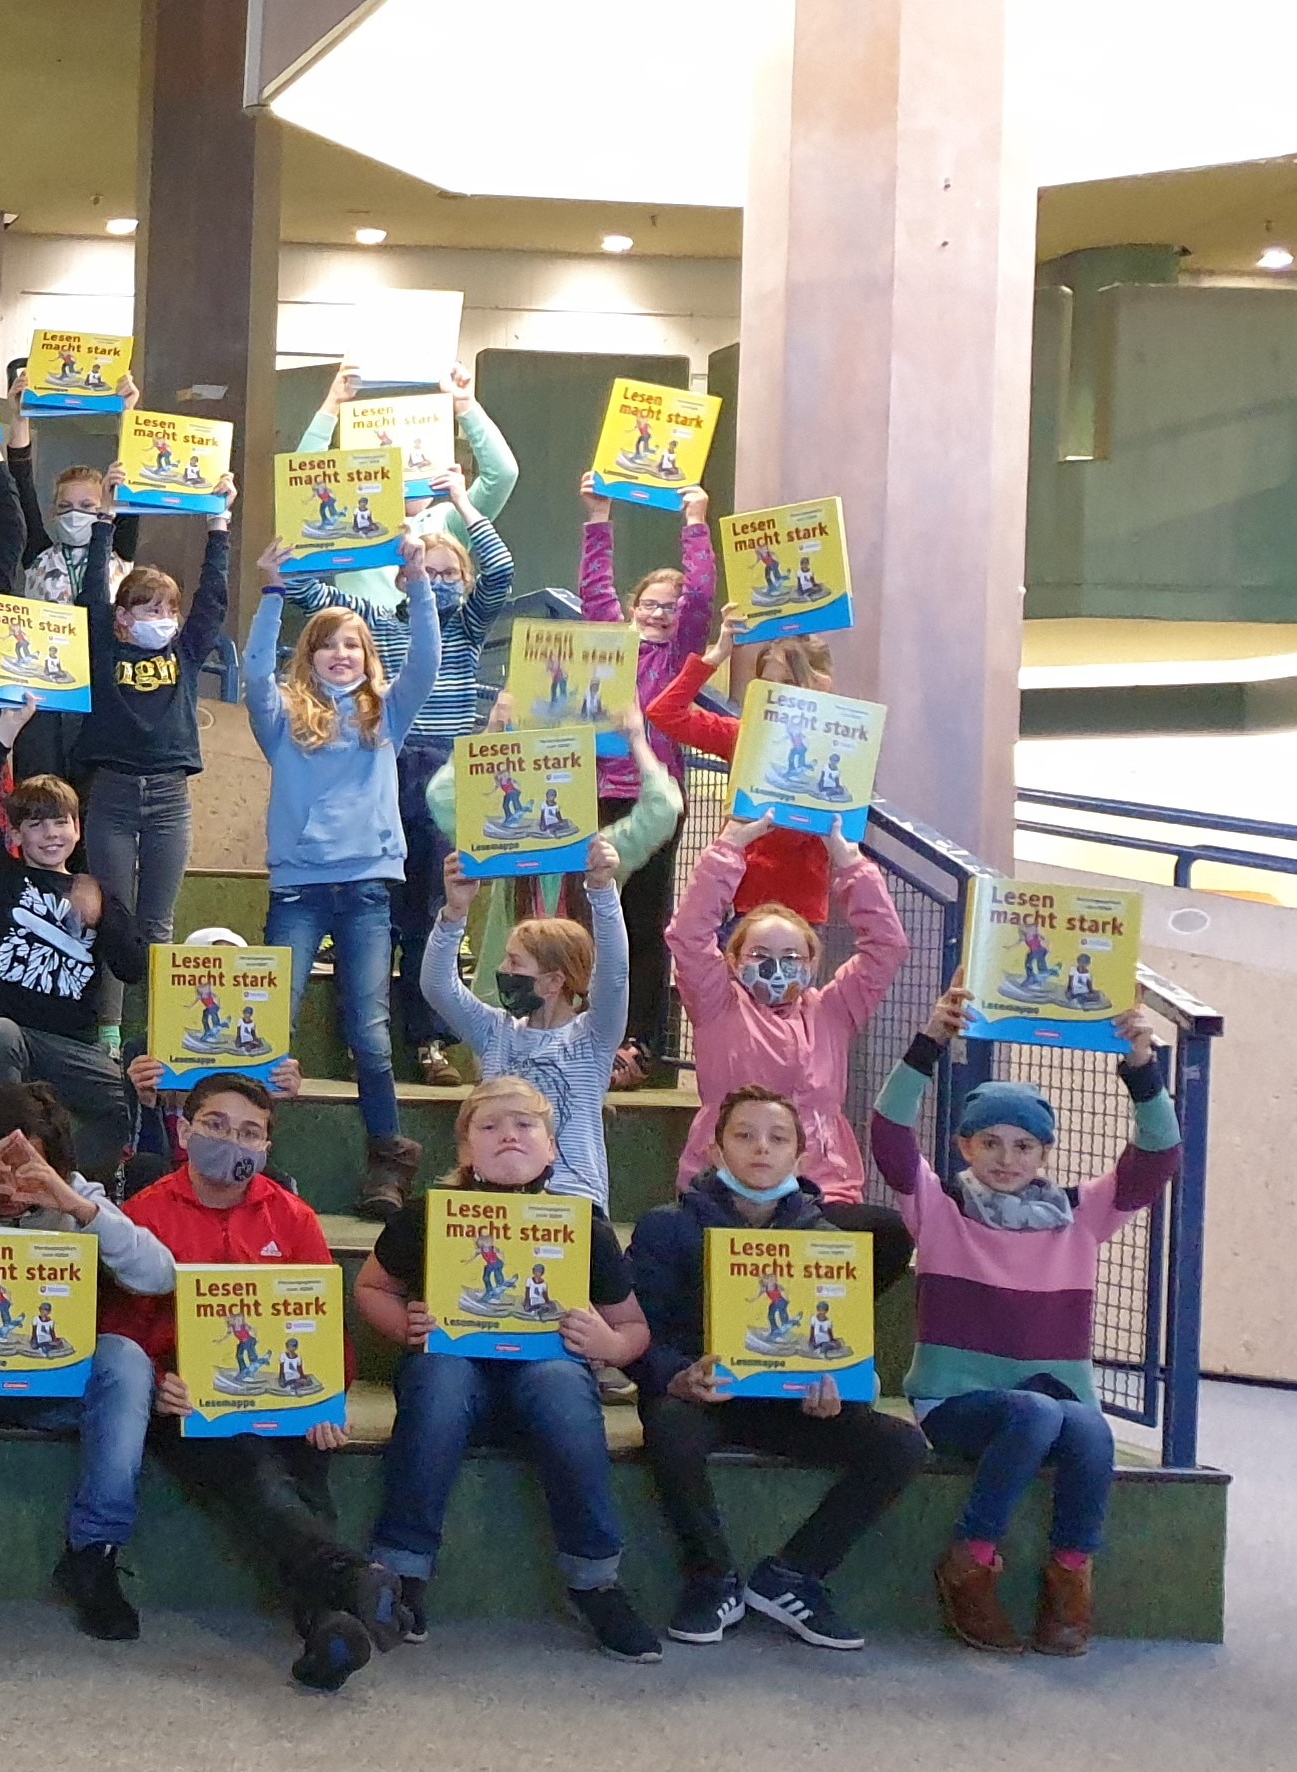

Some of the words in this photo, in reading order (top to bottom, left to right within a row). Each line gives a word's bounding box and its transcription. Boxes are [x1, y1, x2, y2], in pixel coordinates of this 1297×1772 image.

[43, 332, 80, 344] Lesen
[41, 341, 82, 353] macht
[87, 345, 120, 357] stark
[623, 387, 662, 405] Lesen
[135, 416, 176, 430] Lesen
[619, 402, 661, 420] macht
[666, 411, 703, 429] stark
[134, 427, 177, 442] macht
[183, 434, 218, 446] stark
[288, 458, 336, 472] Lesen
[289, 471, 341, 485] macht
[347, 468, 390, 481] stark
[732, 516, 776, 536] Lesen
[734, 532, 781, 552] macht
[786, 523, 828, 541] stark
[39, 620, 76, 635] stark
[767, 690, 817, 712] Lesen
[763, 708, 818, 731] macht
[824, 722, 868, 741] stark
[469, 741, 521, 758] Lesen
[469, 757, 526, 776] macht
[533, 753, 581, 770] stark
[992, 886, 1054, 908] Lesen
[990, 910, 1056, 930] macht
[1066, 916, 1124, 936] stark
[171, 952, 222, 969] Lesen
[171, 971, 225, 987] macht
[232, 971, 278, 987] stark
[446, 1199, 507, 1219] Lesen
[446, 1220, 512, 1239] macht
[519, 1223, 574, 1243] stark
[729, 1238, 790, 1257] Lesen
[26, 1263, 81, 1282] stark
[730, 1260, 794, 1279] macht
[803, 1260, 856, 1280] stark
[196, 1279, 257, 1297] Lesen
[196, 1299, 262, 1317] macht
[271, 1297, 326, 1316] stark
